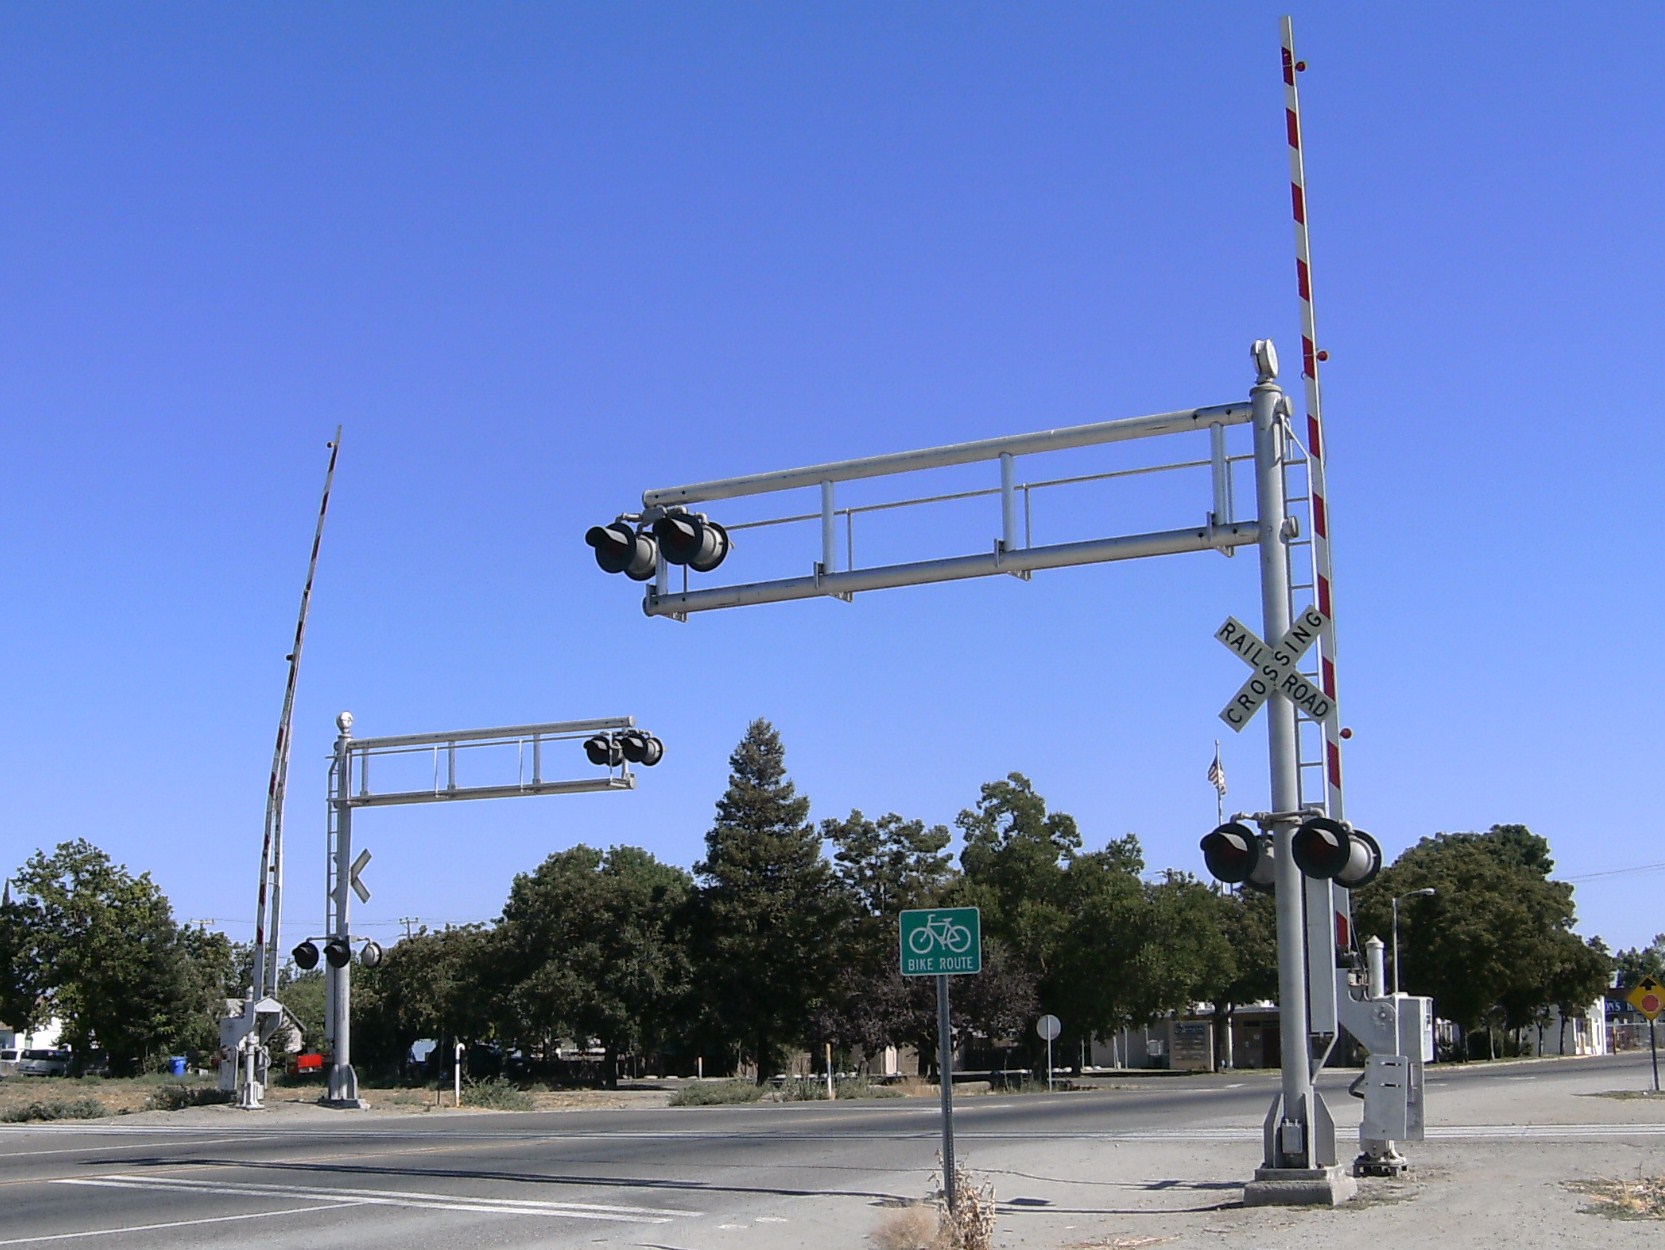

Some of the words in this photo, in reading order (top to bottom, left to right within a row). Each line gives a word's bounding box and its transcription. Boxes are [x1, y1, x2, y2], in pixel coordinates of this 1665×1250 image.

[1219, 622, 1263, 667] RAIL
[1281, 674, 1329, 718] ROAD
[1226, 612, 1322, 723] CROSSING
[908, 958, 934, 971] BIKE
[939, 956, 973, 970] ROUTE
